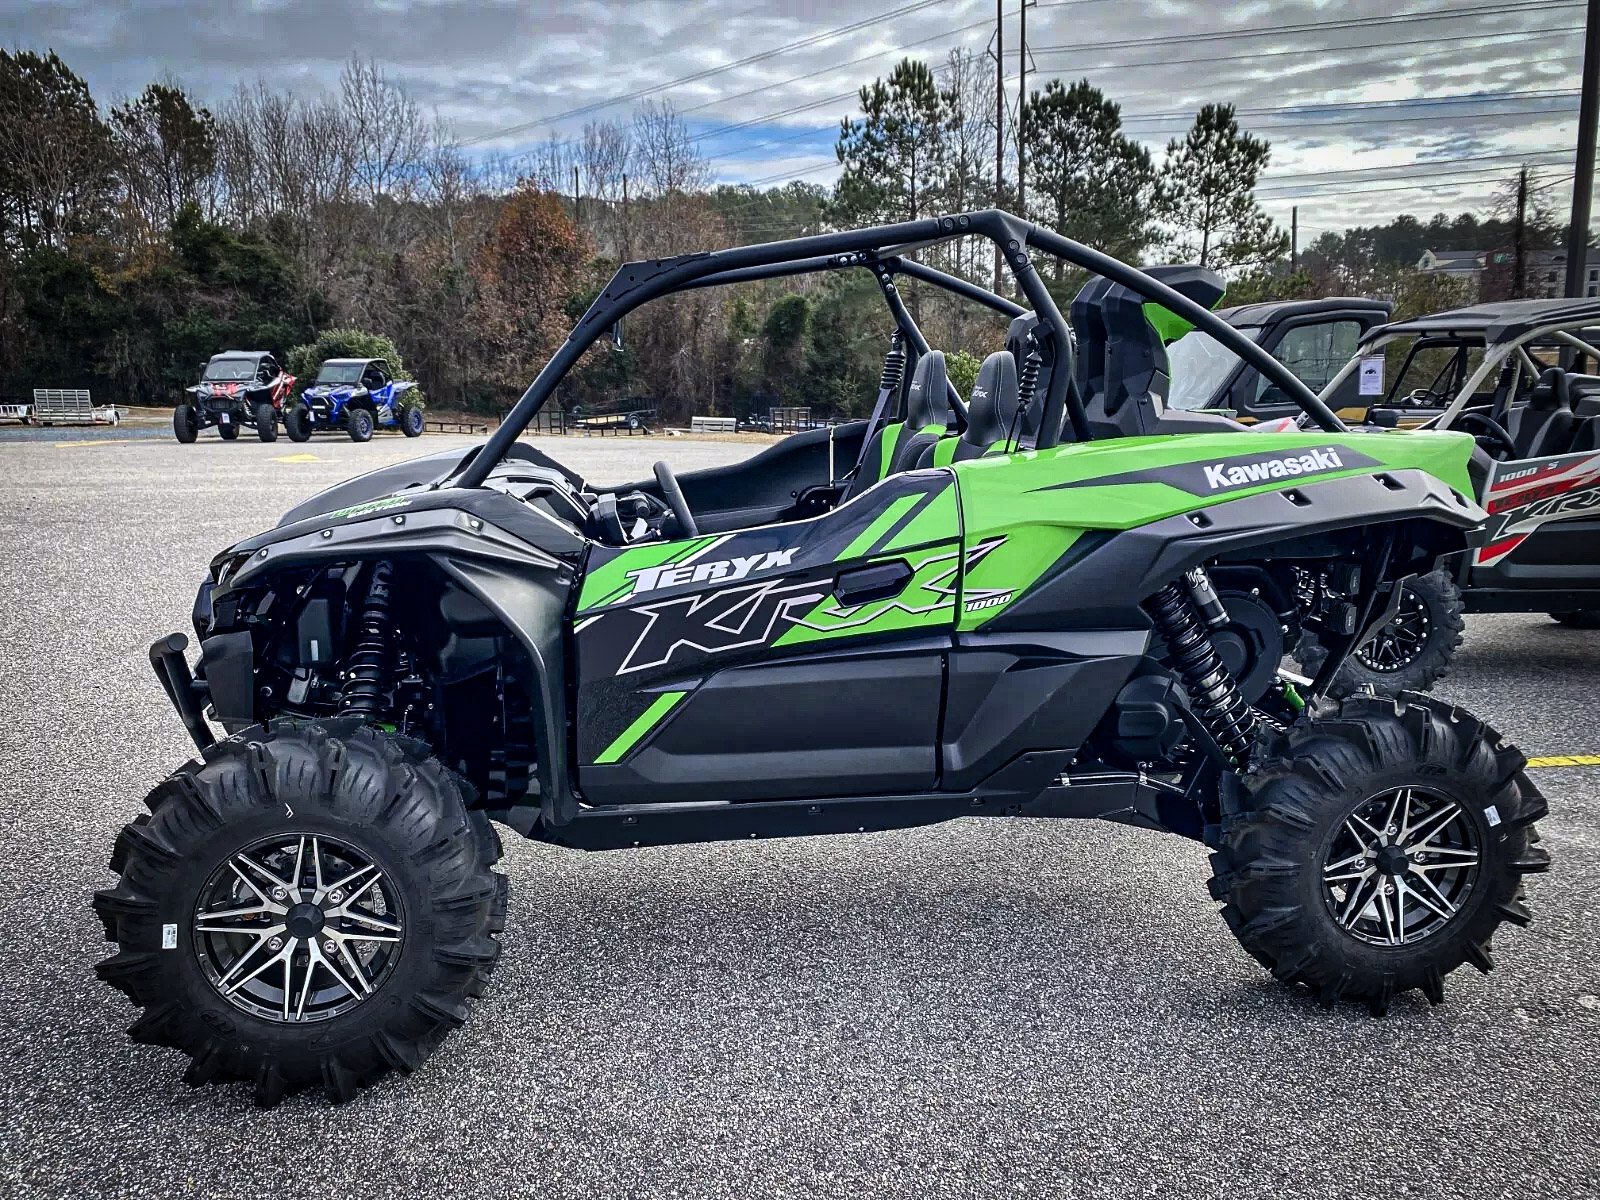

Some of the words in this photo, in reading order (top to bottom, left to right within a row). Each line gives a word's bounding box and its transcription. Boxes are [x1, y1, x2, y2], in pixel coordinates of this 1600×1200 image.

[1203, 447, 1344, 489] Kawasaki
[1499, 466, 1538, 483] 1000
[1547, 460, 1560, 471] S
[626, 547, 800, 594] TERYX
[964, 593, 1013, 613] 1000
